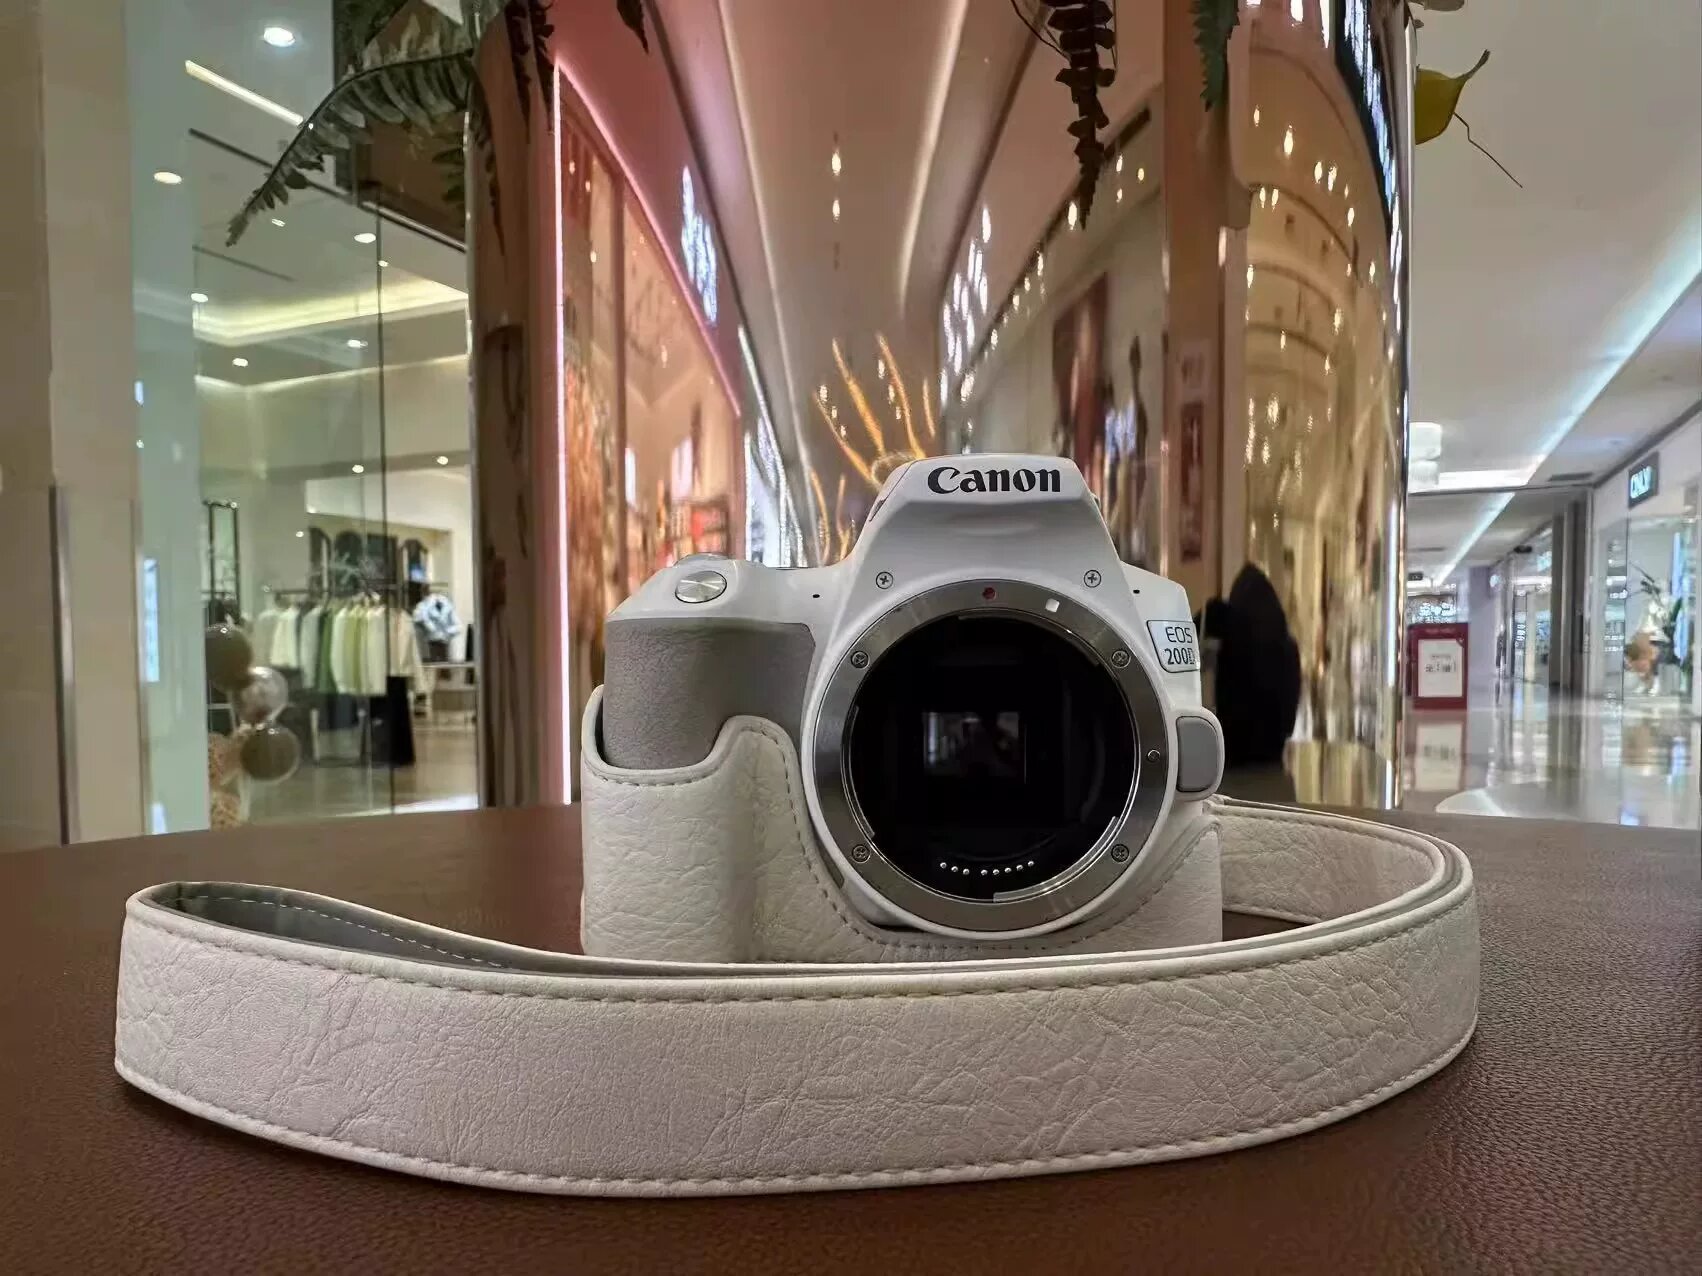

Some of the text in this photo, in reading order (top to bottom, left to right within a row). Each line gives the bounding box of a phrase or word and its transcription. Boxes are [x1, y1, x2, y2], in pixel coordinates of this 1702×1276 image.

[927, 466, 1061, 494] Canon
[1165, 626, 1193, 644] EOS
[1163, 647, 1196, 665] 200D
